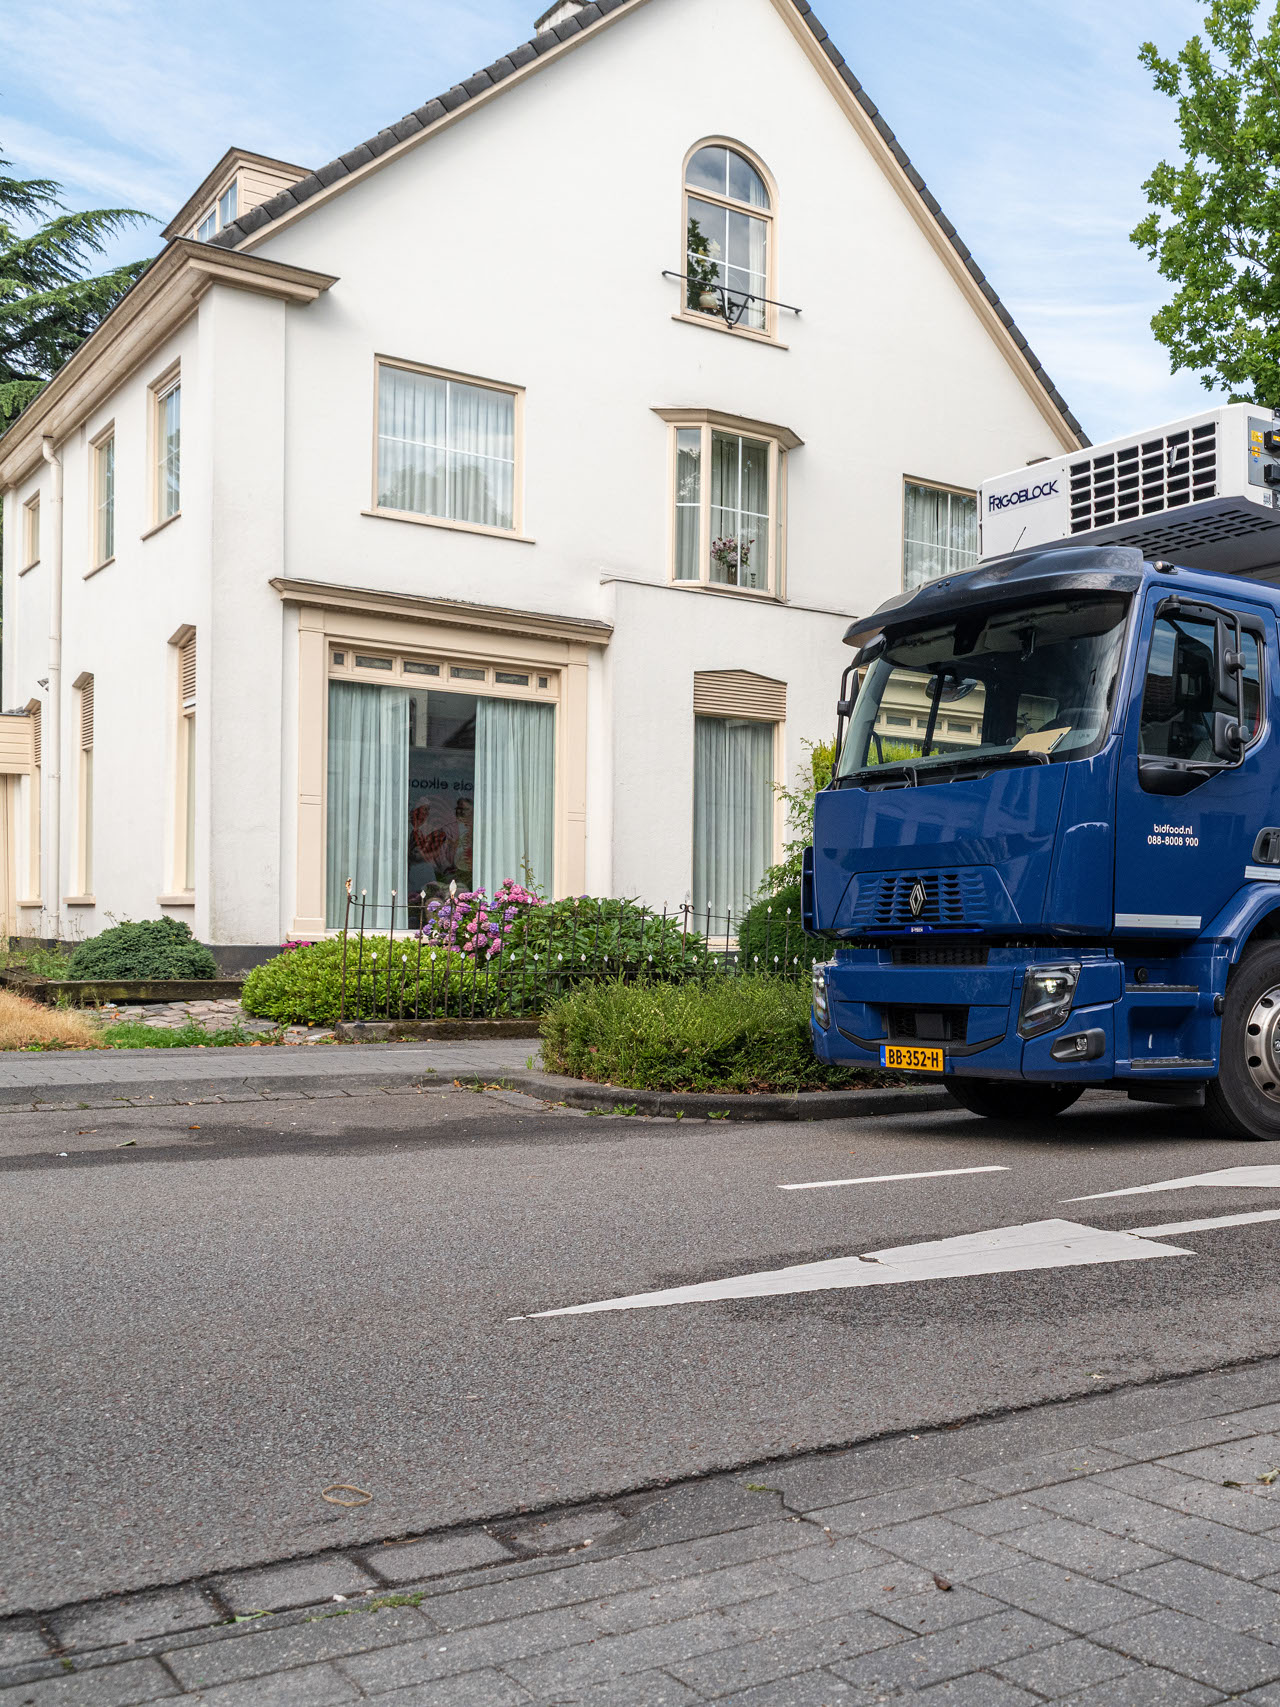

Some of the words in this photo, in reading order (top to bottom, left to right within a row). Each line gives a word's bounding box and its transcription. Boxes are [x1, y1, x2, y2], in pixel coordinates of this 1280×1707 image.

[988, 479, 1059, 512] FRIGOBLOCK
[1153, 823, 1193, 835] bidfood.nl
[1147, 835, 1184, 846] 088-8008
[1185, 837, 1199, 847] 900
[888, 1049, 939, 1068] BB-352-H
